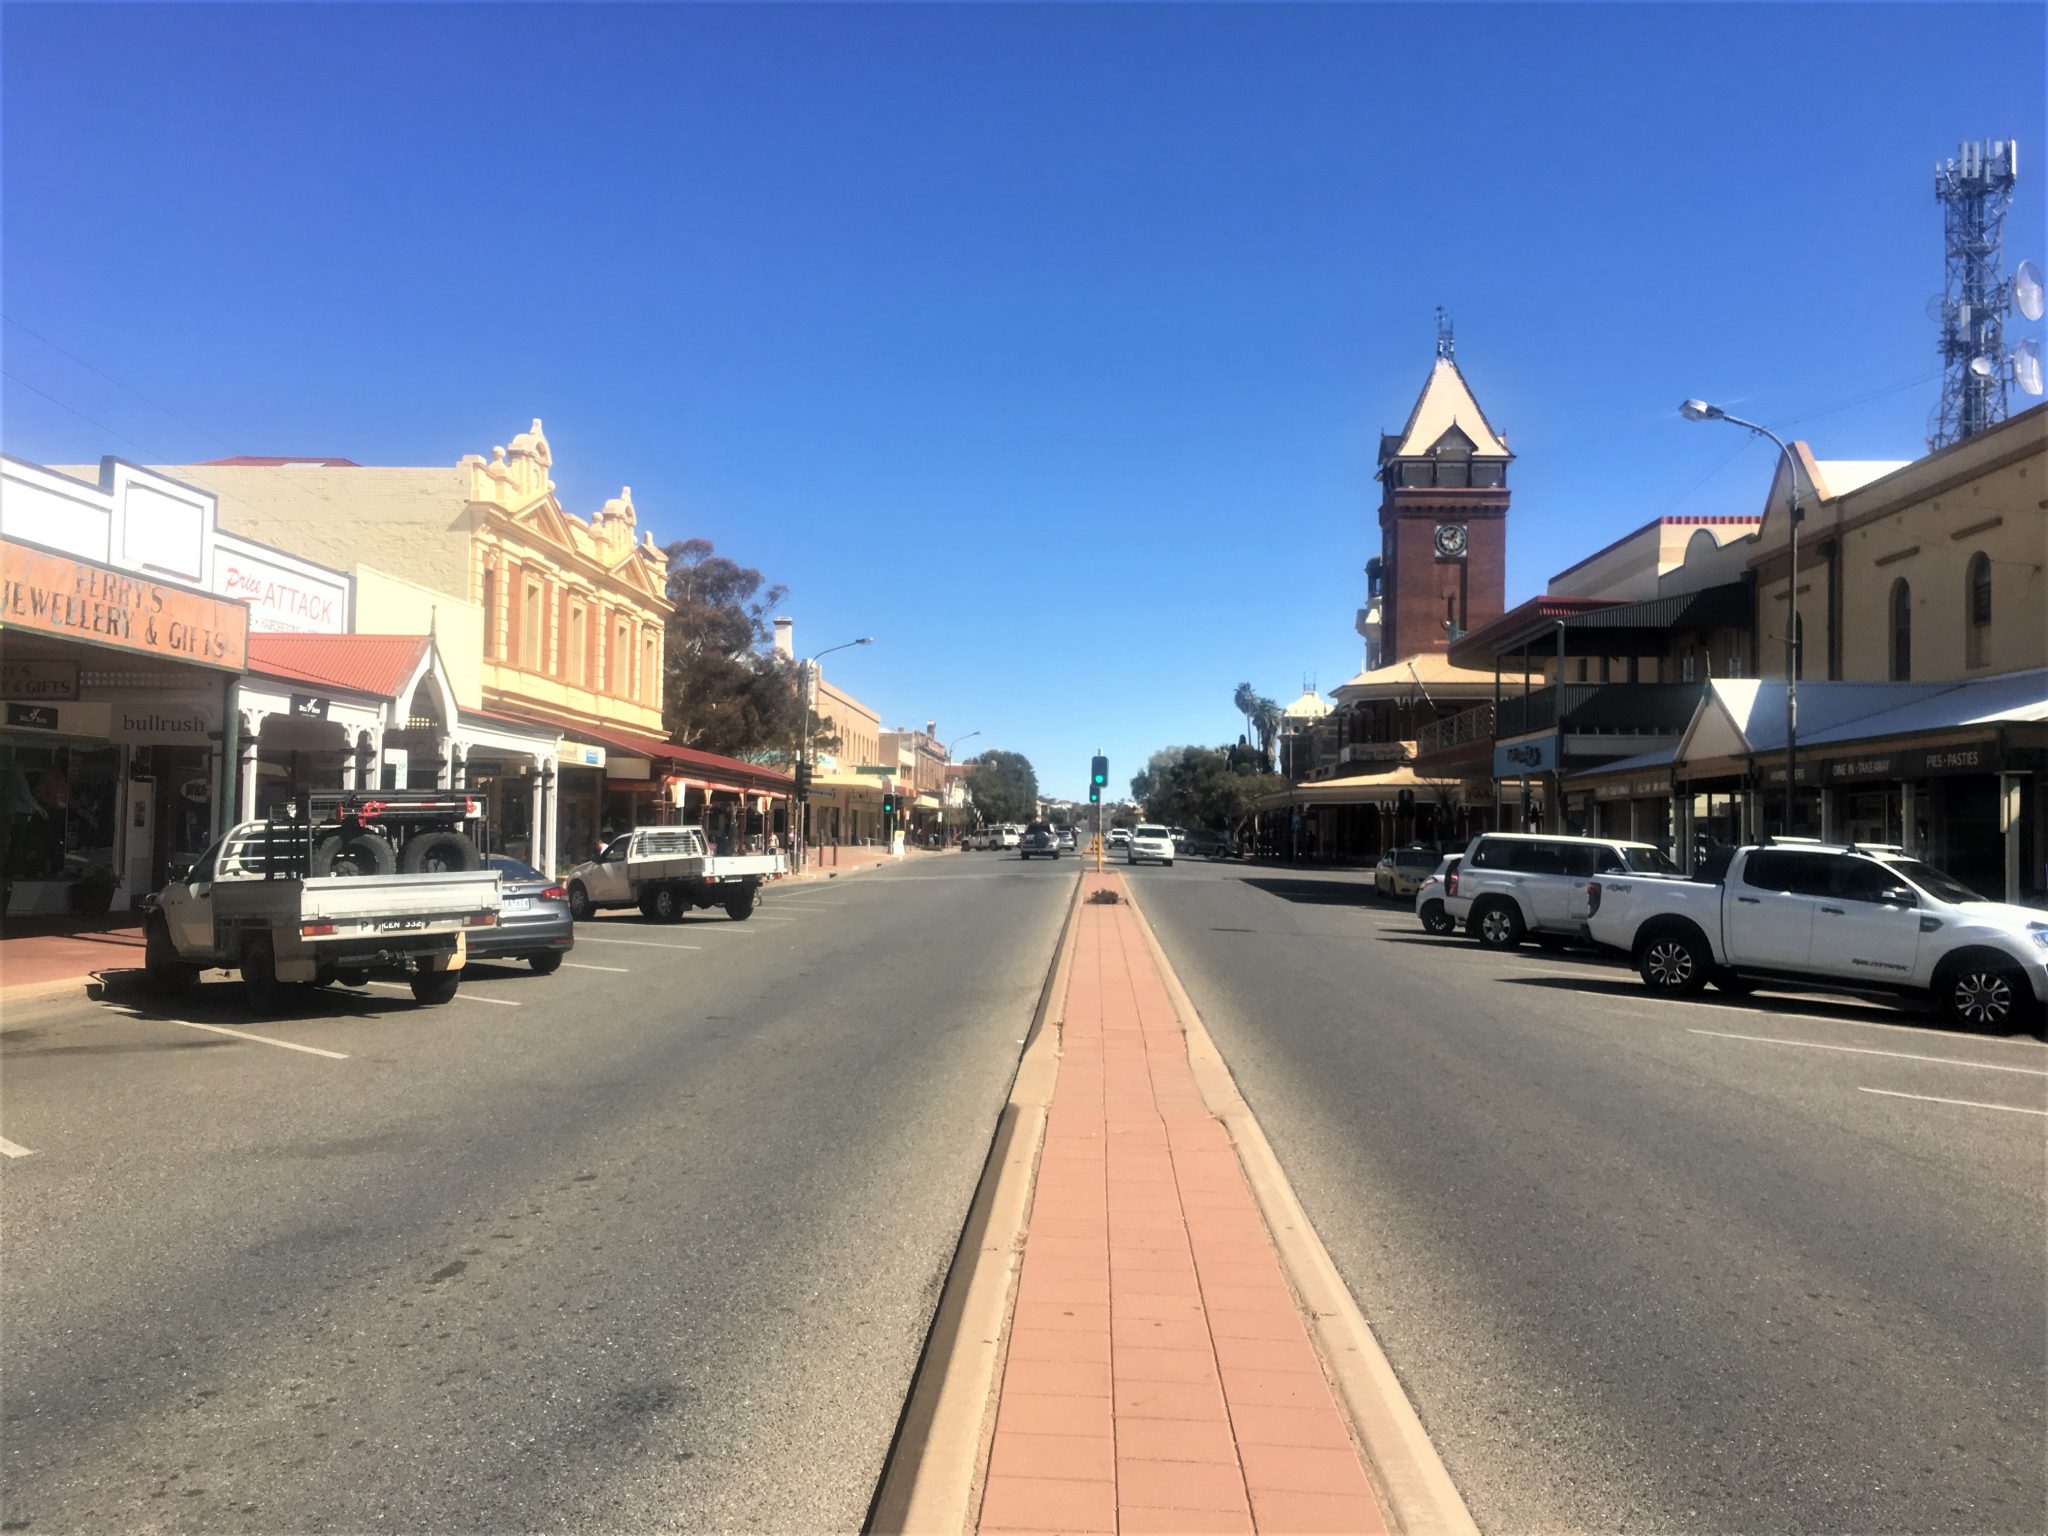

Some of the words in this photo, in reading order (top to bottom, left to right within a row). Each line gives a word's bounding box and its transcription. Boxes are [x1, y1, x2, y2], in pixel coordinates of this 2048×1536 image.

[225, 567, 262, 592] Price
[262, 582, 333, 624] ATTACK
[0, 580, 135, 640] JEWELLERY
[145, 616, 158, 645] &
[169, 621, 225, 659] GIFTS
[25, 679, 72, 694] GIFTS
[122, 714, 205, 732] bullrush
